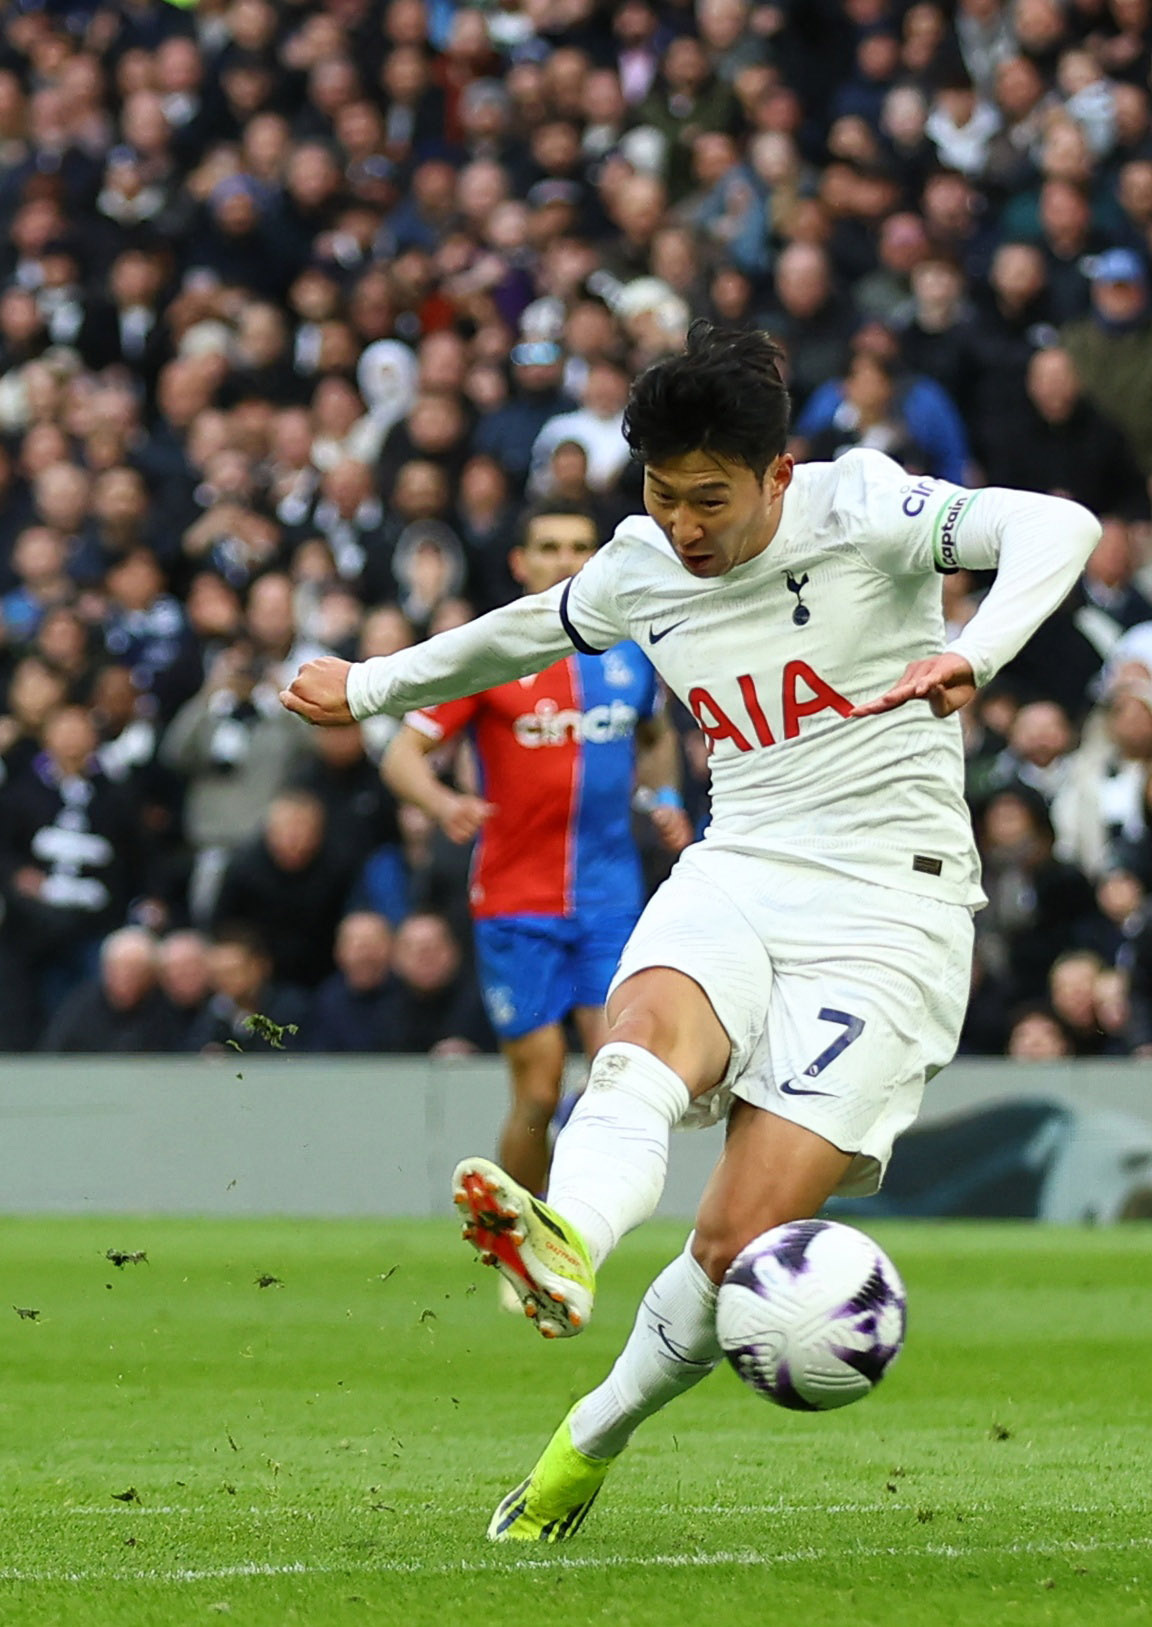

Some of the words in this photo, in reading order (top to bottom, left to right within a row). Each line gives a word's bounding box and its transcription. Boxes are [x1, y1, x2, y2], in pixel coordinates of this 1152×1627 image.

[942, 497, 969, 566] captain
[512, 698, 638, 750] cinch
[688, 659, 858, 755] AIA
[803, 1007, 866, 1078] 7
